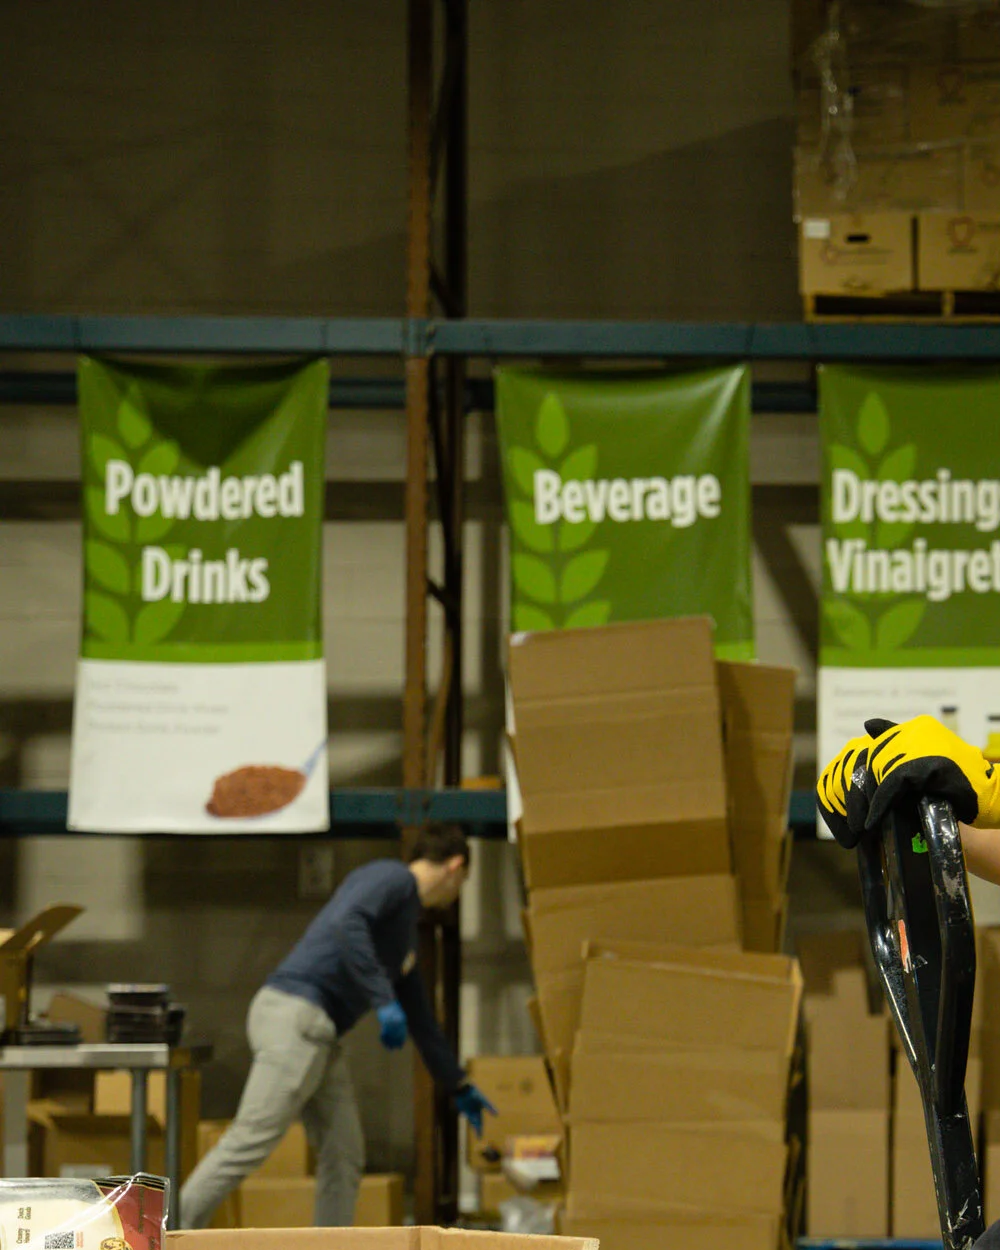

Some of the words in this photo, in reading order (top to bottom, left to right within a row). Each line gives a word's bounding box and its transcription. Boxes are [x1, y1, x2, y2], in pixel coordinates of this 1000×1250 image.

[105, 459, 304, 521] Powdered
[533, 469, 721, 528] Beverage
[141, 545, 270, 604] Drinks
